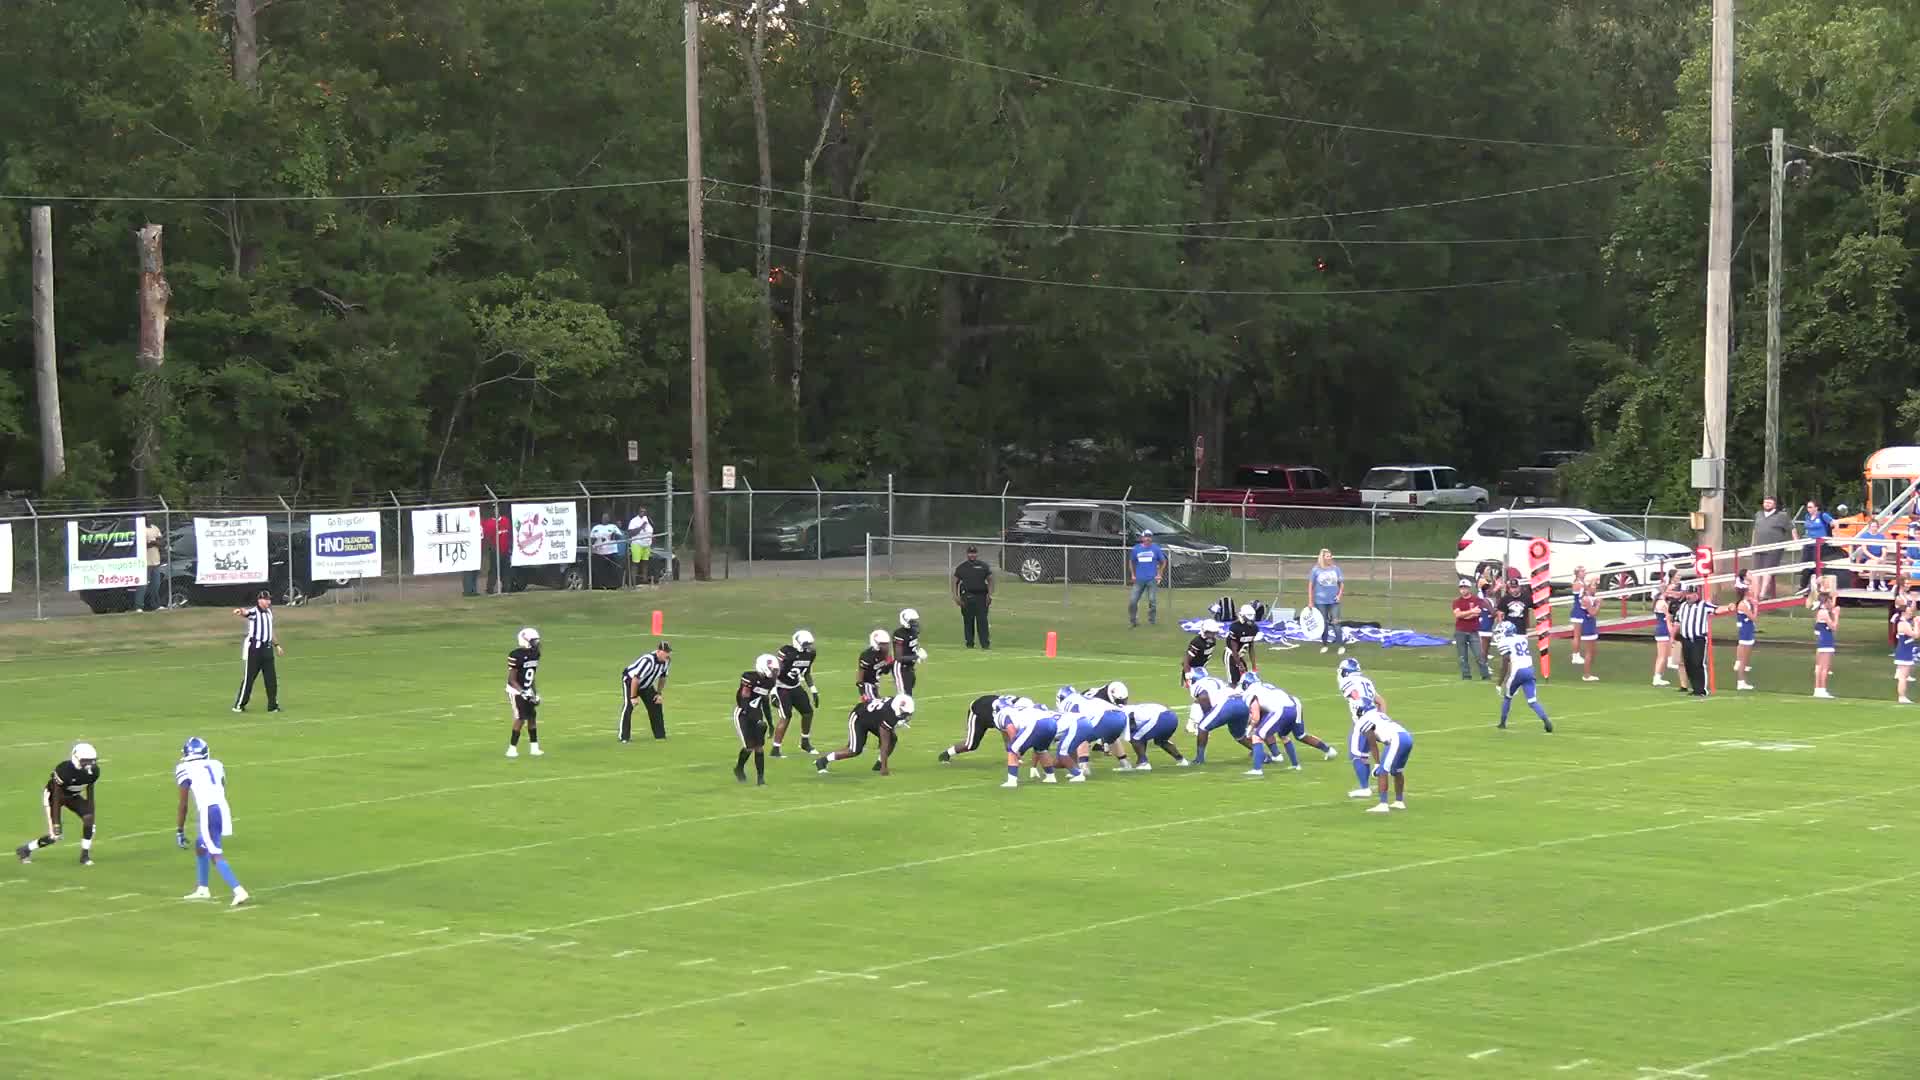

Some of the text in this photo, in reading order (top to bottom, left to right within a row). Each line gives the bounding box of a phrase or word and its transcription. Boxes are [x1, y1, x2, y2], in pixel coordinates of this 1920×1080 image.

[318, 537, 344, 553] HNO
[1696, 548, 1711, 575] 2
[1515, 641, 1530, 656] 82
[524, 668, 534, 687] 9
[1361, 681, 1375, 699] 15
[204, 765, 216, 785] 1
